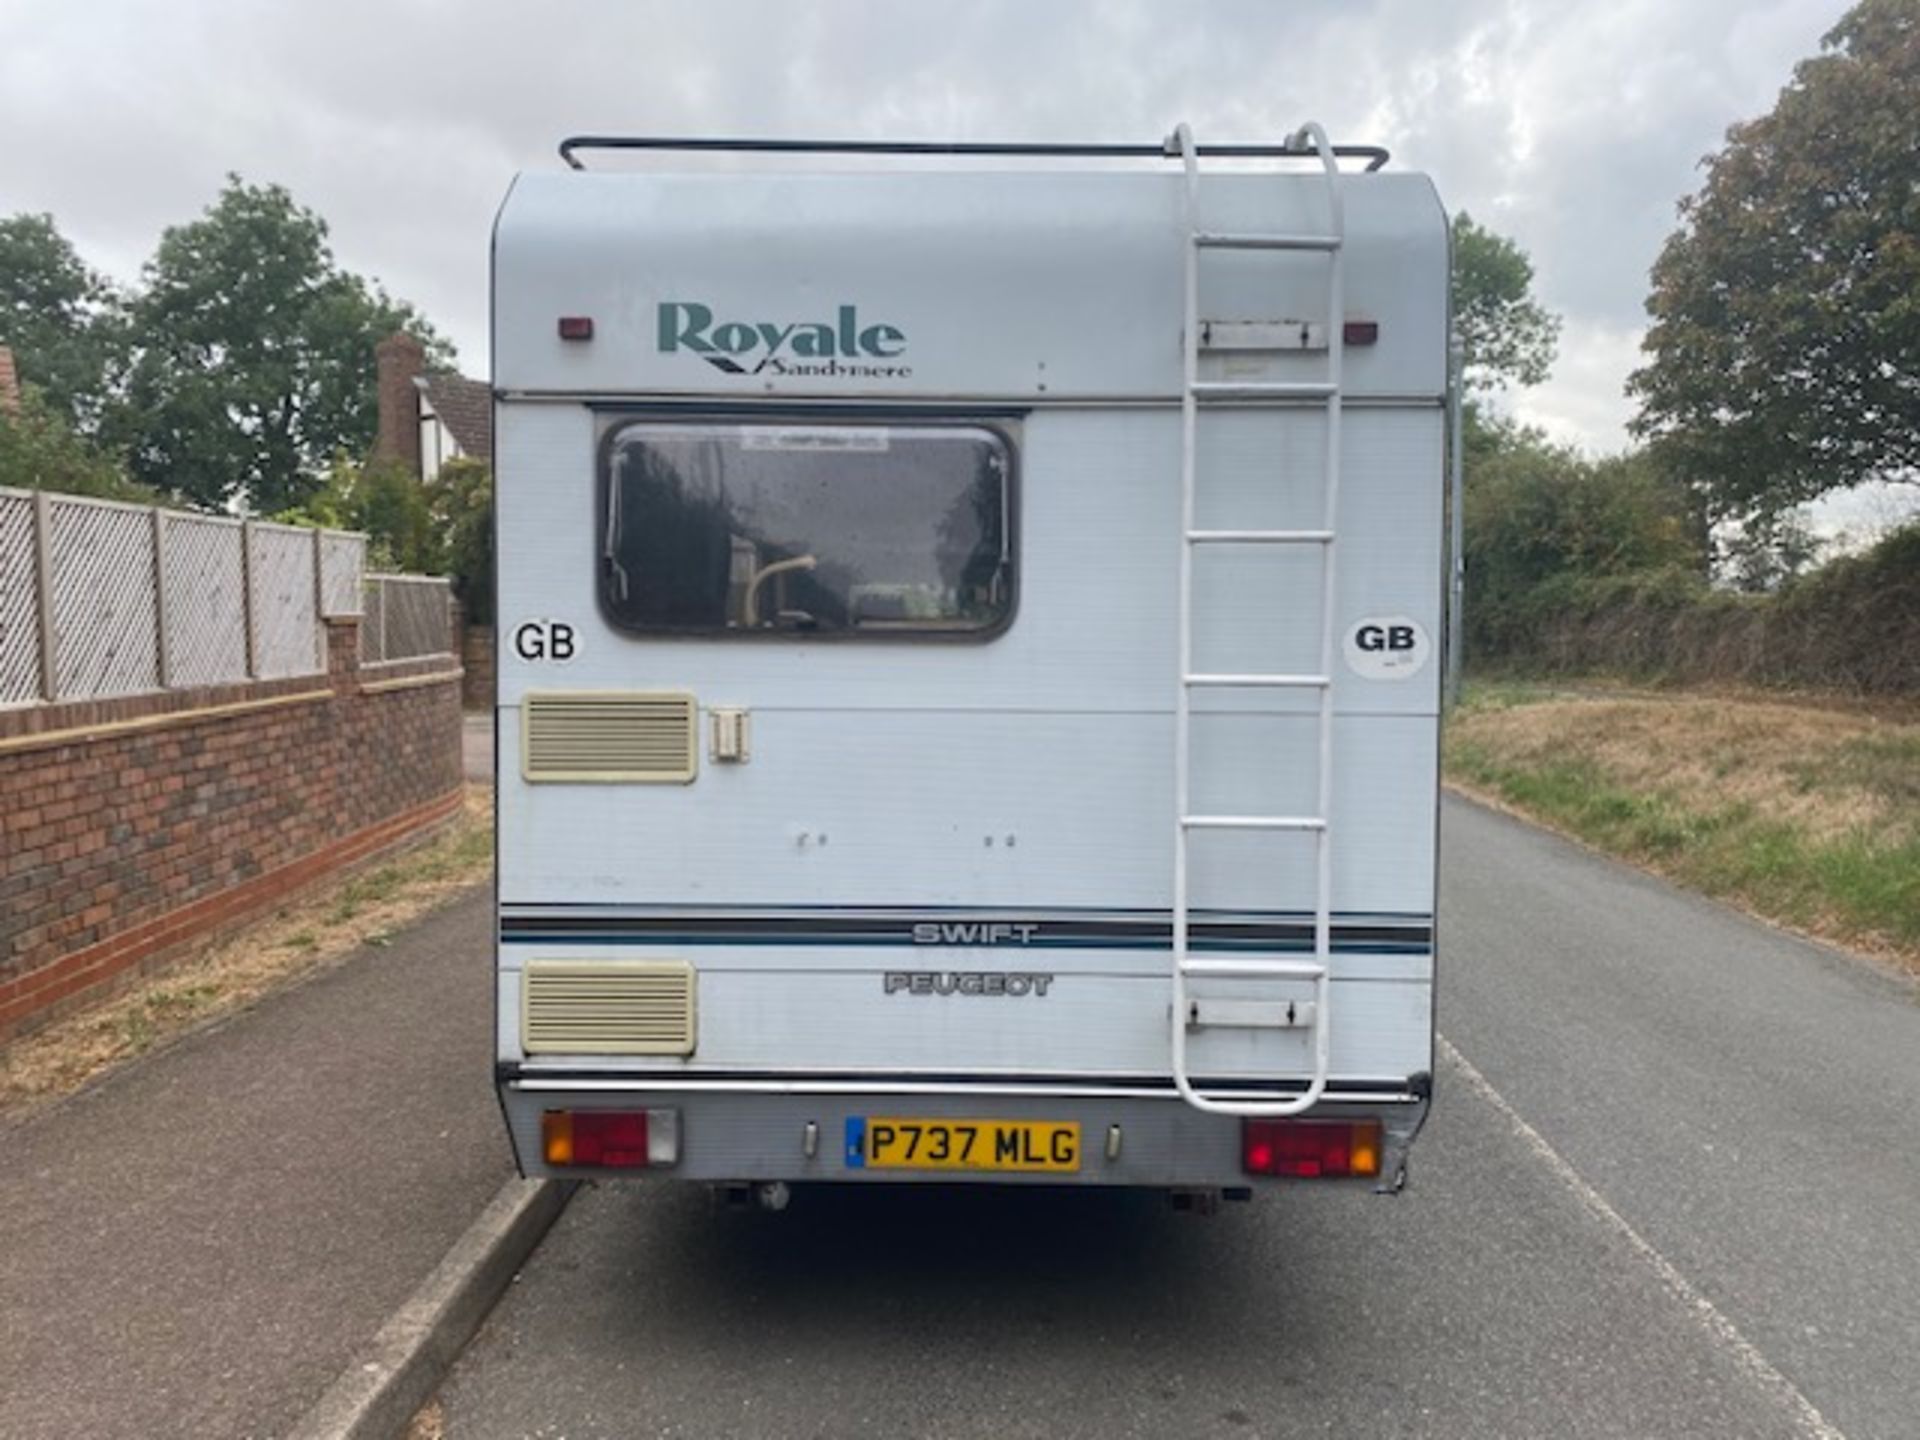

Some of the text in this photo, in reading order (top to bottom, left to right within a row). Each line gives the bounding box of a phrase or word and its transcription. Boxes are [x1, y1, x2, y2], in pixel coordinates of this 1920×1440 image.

[657, 302, 907, 358] Royale
[516, 623, 574, 660] GB
[1355, 625, 1416, 652] GB
[912, 922, 1038, 945] SWIFT
[884, 972, 1053, 996] PEUGEOT
[872, 1126, 1075, 1164] P737 MLG
